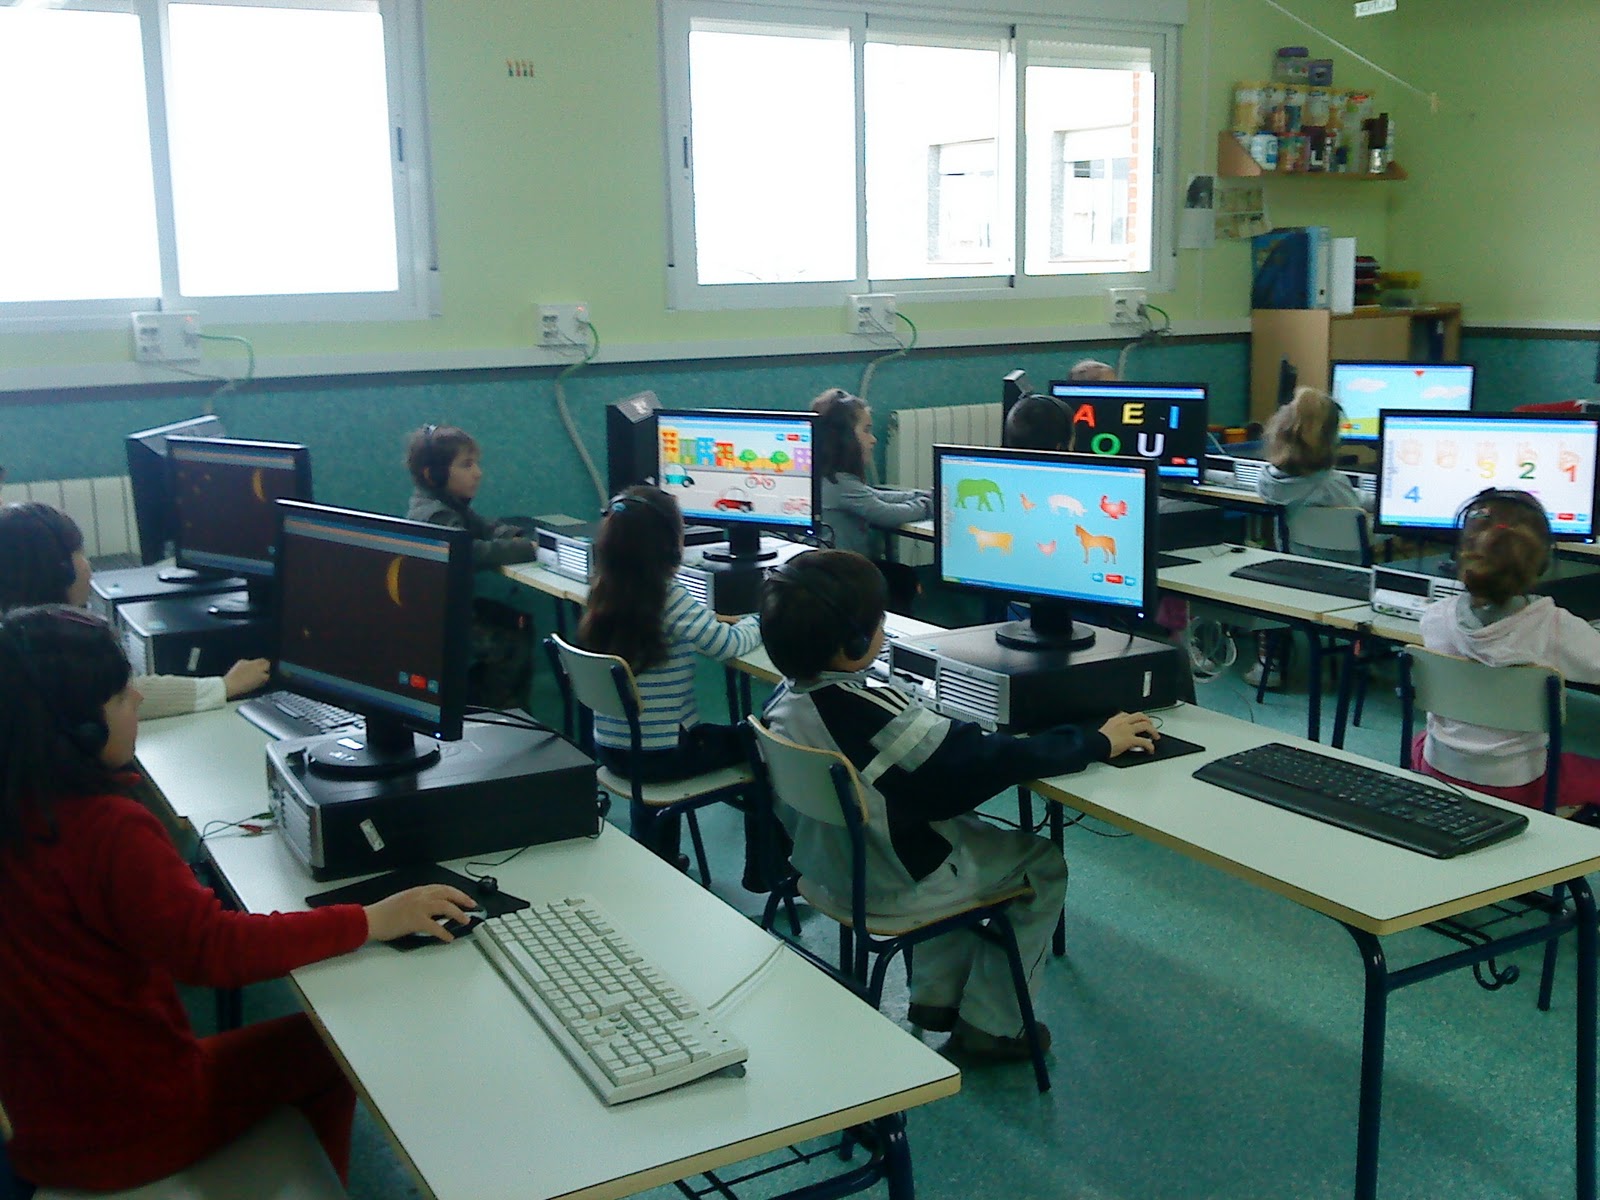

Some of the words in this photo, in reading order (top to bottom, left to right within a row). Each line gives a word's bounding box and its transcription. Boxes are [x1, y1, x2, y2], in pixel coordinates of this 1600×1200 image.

[1073, 403, 1096, 428] A
[1122, 402, 1145, 425] E
[1169, 405, 1180, 429] I
[1091, 432, 1121, 456] O
[1137, 432, 1165, 457] U
[1479, 460, 1496, 479] 3
[1519, 461, 1536, 480] 2
[1564, 464, 1578, 482] 1
[1404, 485, 1422, 503] 4
